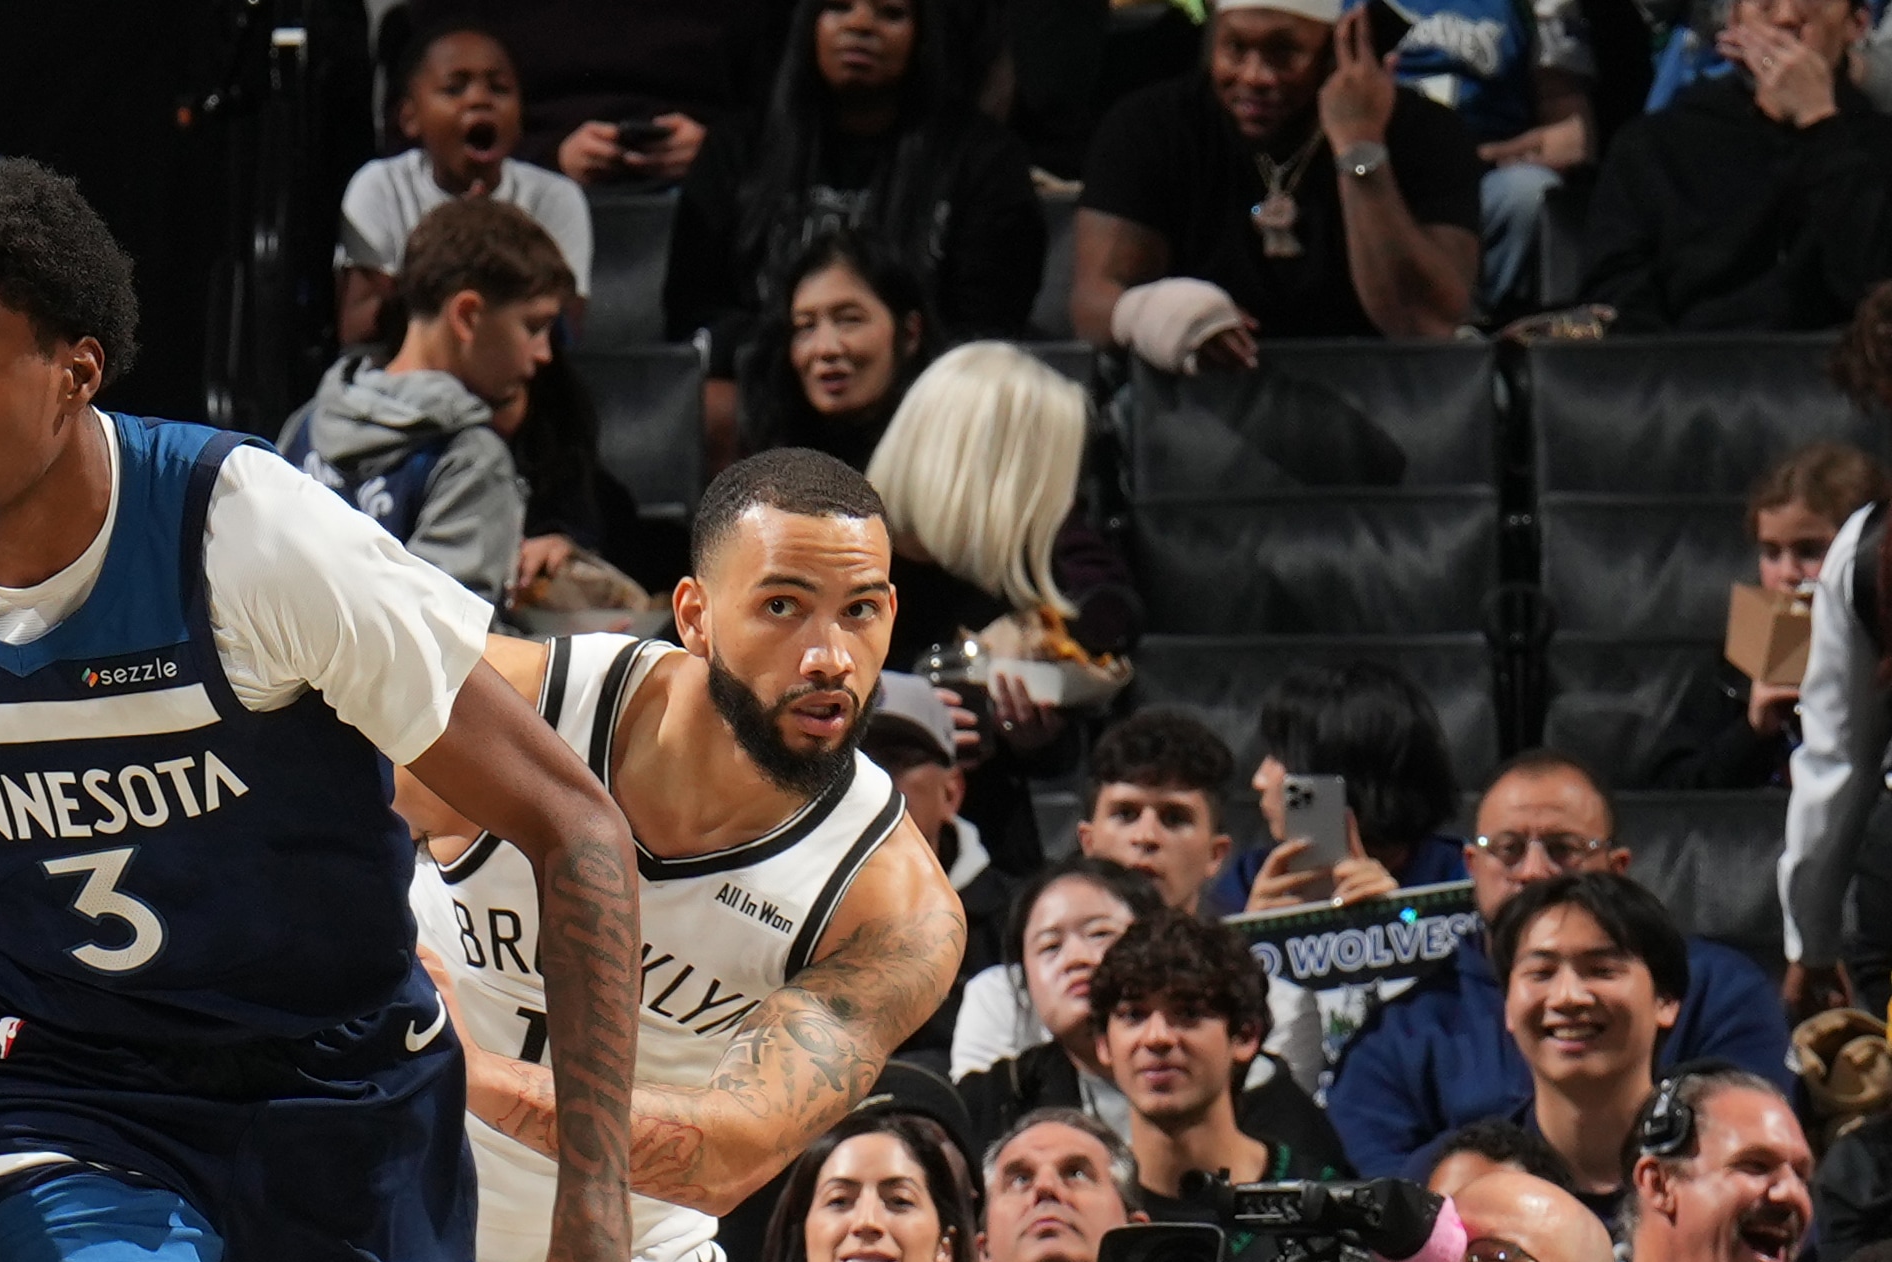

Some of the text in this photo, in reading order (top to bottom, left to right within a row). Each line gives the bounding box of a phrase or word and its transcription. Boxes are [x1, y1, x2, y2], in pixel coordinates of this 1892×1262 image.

[99, 656, 179, 686] sezzle
[39, 845, 168, 975] 3
[713, 881, 794, 934] All In Won
[451, 897, 762, 1036] BRKLYN
